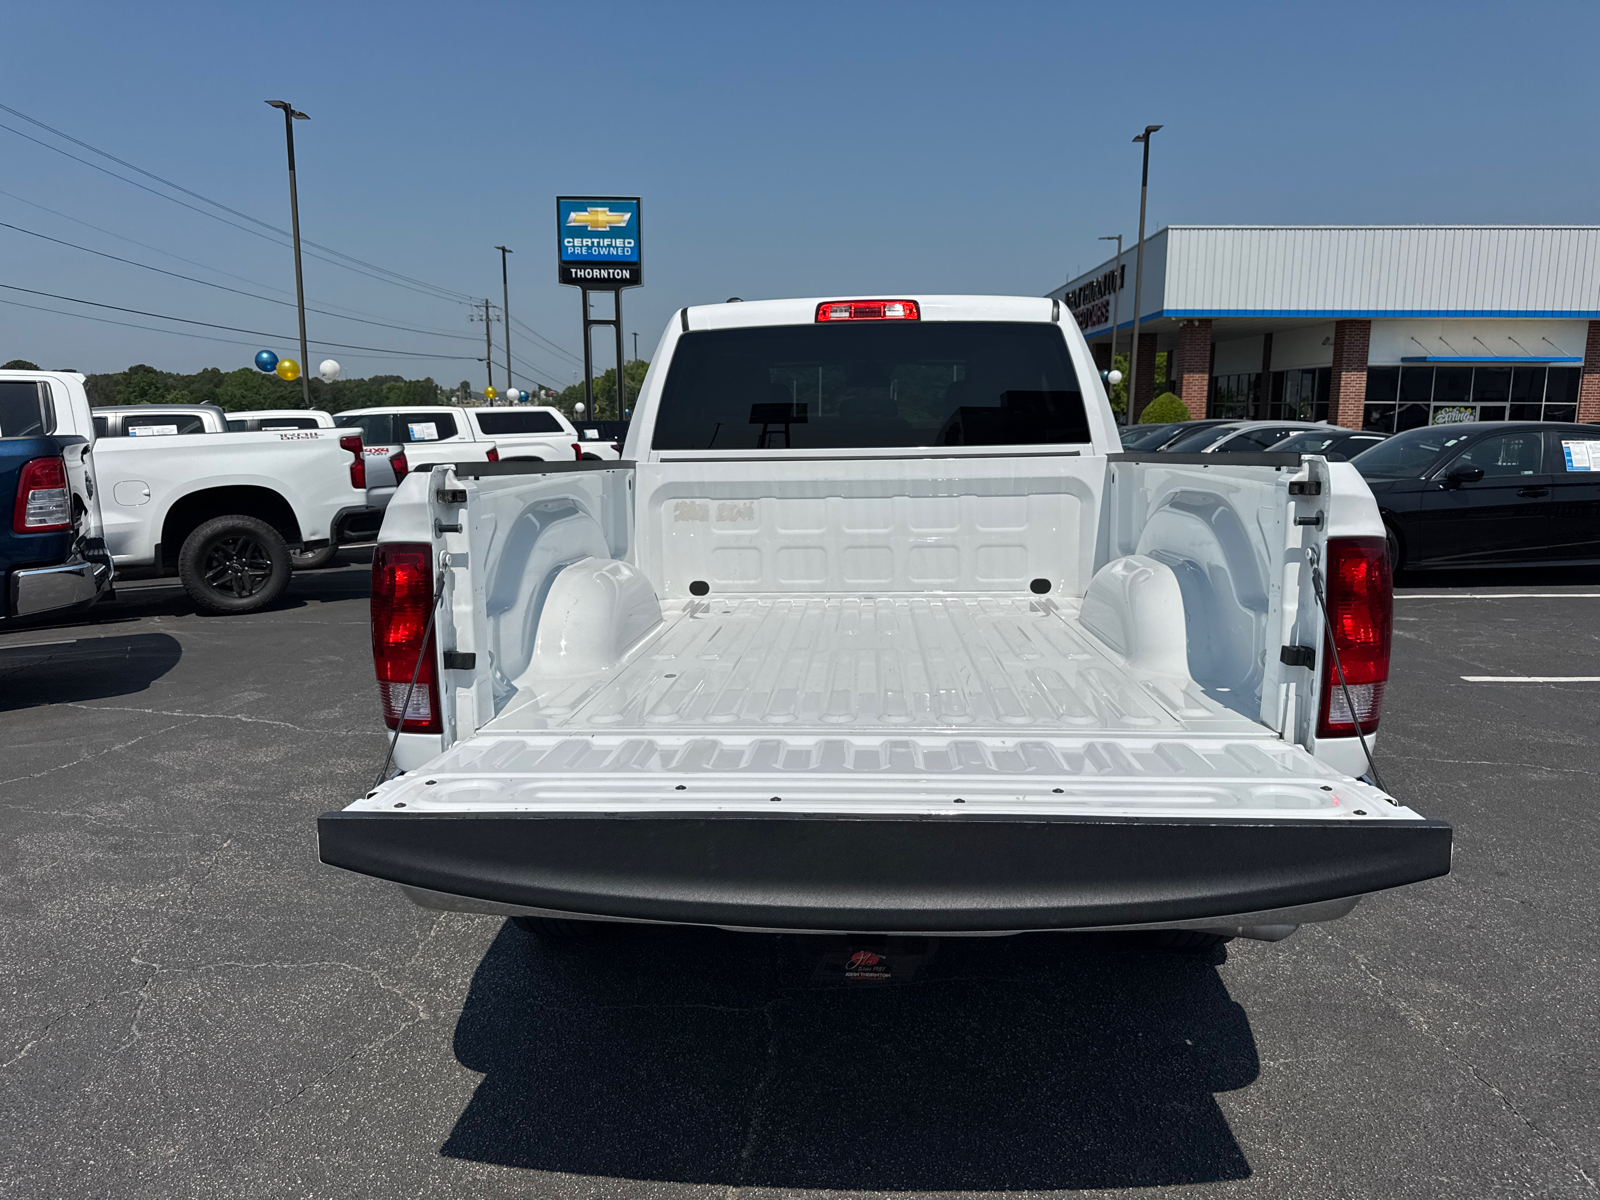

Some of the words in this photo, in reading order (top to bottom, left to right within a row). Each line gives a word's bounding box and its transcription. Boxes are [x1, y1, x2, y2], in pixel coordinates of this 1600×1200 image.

[564, 238, 635, 247] CERTIFIED
[567, 247, 632, 256] PRE-OWNED
[570, 268, 631, 279] THORNTON
[1435, 407, 1472, 424] Spring
